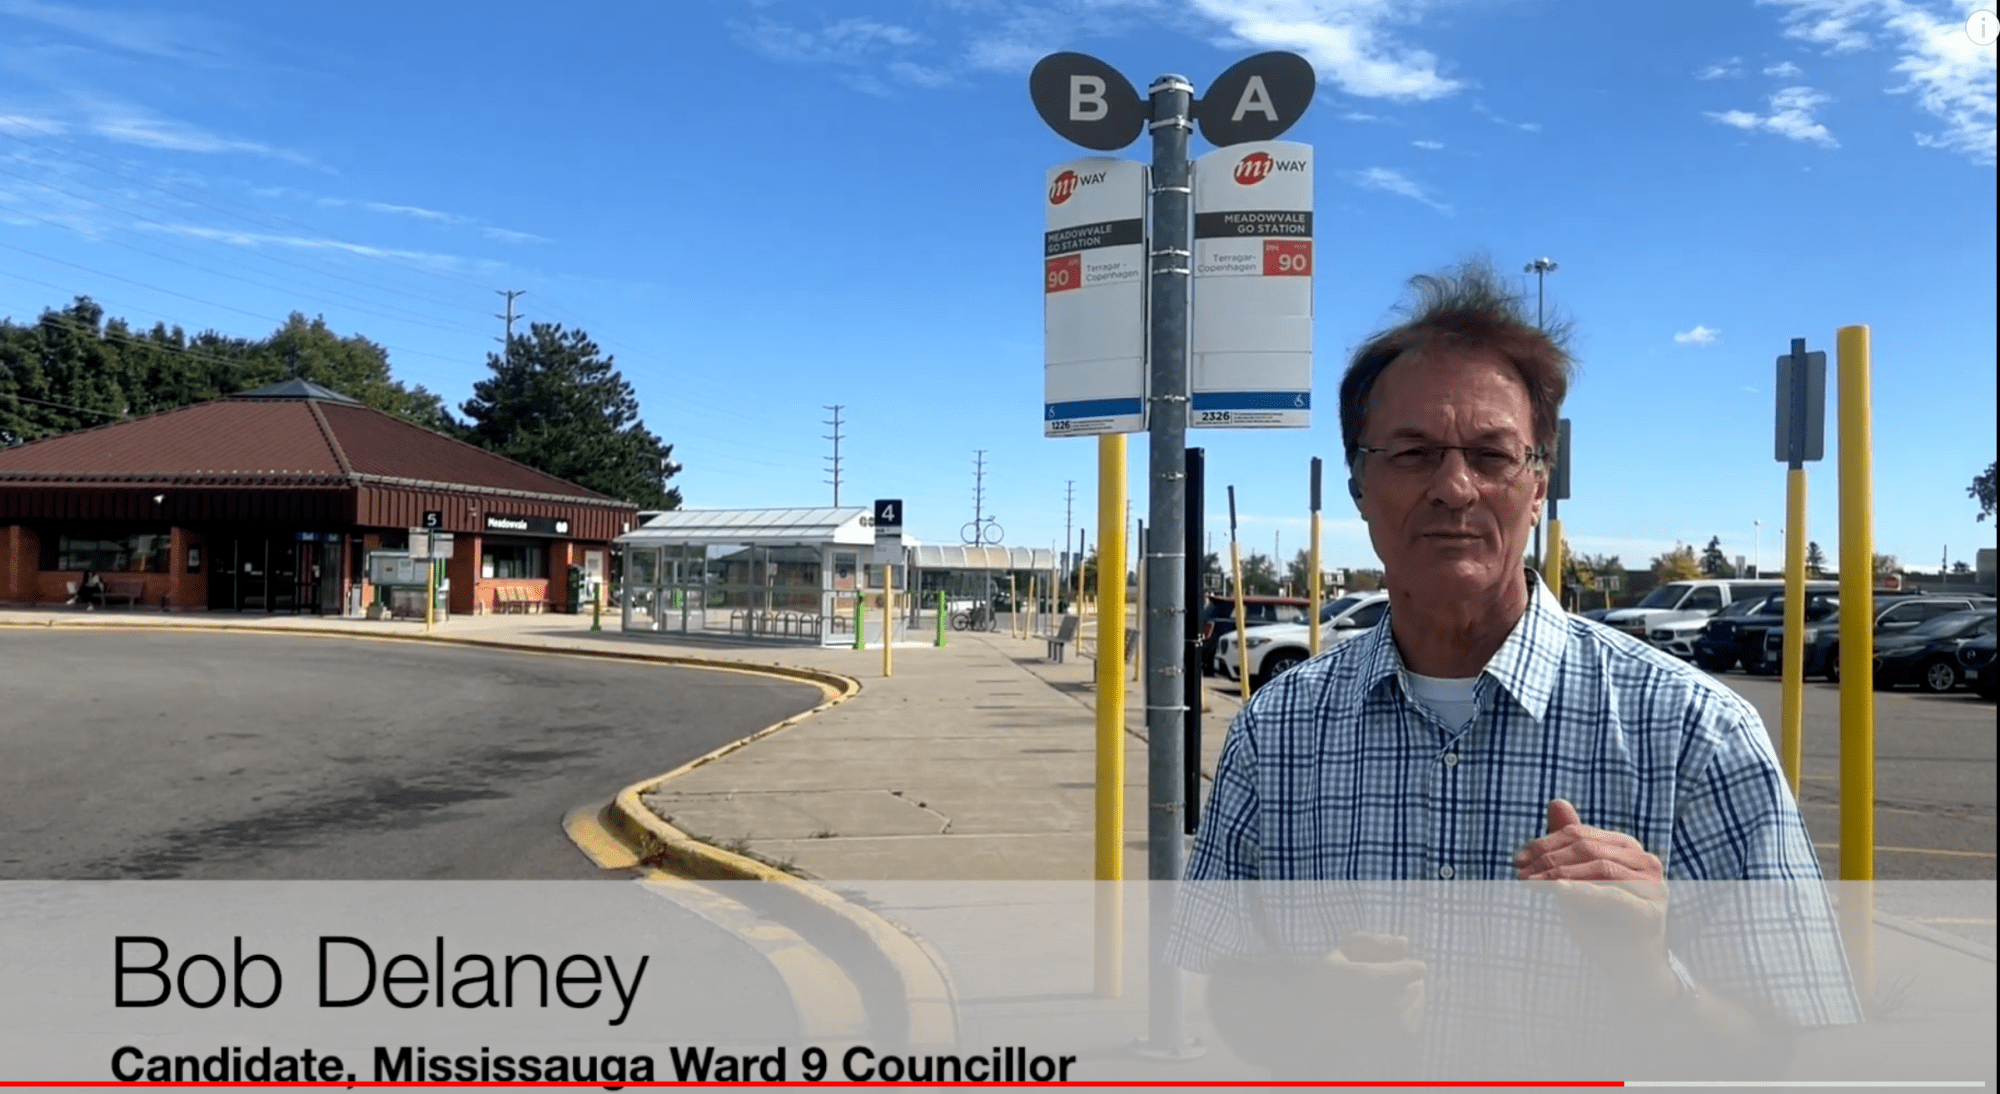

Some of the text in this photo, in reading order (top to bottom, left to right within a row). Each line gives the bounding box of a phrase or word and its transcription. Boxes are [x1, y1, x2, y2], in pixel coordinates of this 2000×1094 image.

[1069, 75, 1109, 121] B
[1231, 75, 1280, 121] A
[1276, 161, 1307, 171] WAY
[1080, 171, 1107, 186] WAY
[1224, 213, 1306, 223] MEADOWVALE
[1048, 224, 1113, 242] MEADOWVALE
[1237, 224, 1306, 234] GO STATION
[1048, 236, 1101, 253] GO STATION
[1197, 263, 1257, 273] Copenhagen
[1278, 253, 1307, 271] 90
[1048, 269, 1070, 288] 90
[1086, 270, 1139, 282] Copenhagen
[1202, 411, 1230, 421] 2326
[1051, 421, 1071, 430] 1226
[881, 504, 895, 521] 4
[427, 513, 437, 526] 5
[487, 517, 528, 530] Meadowvale
